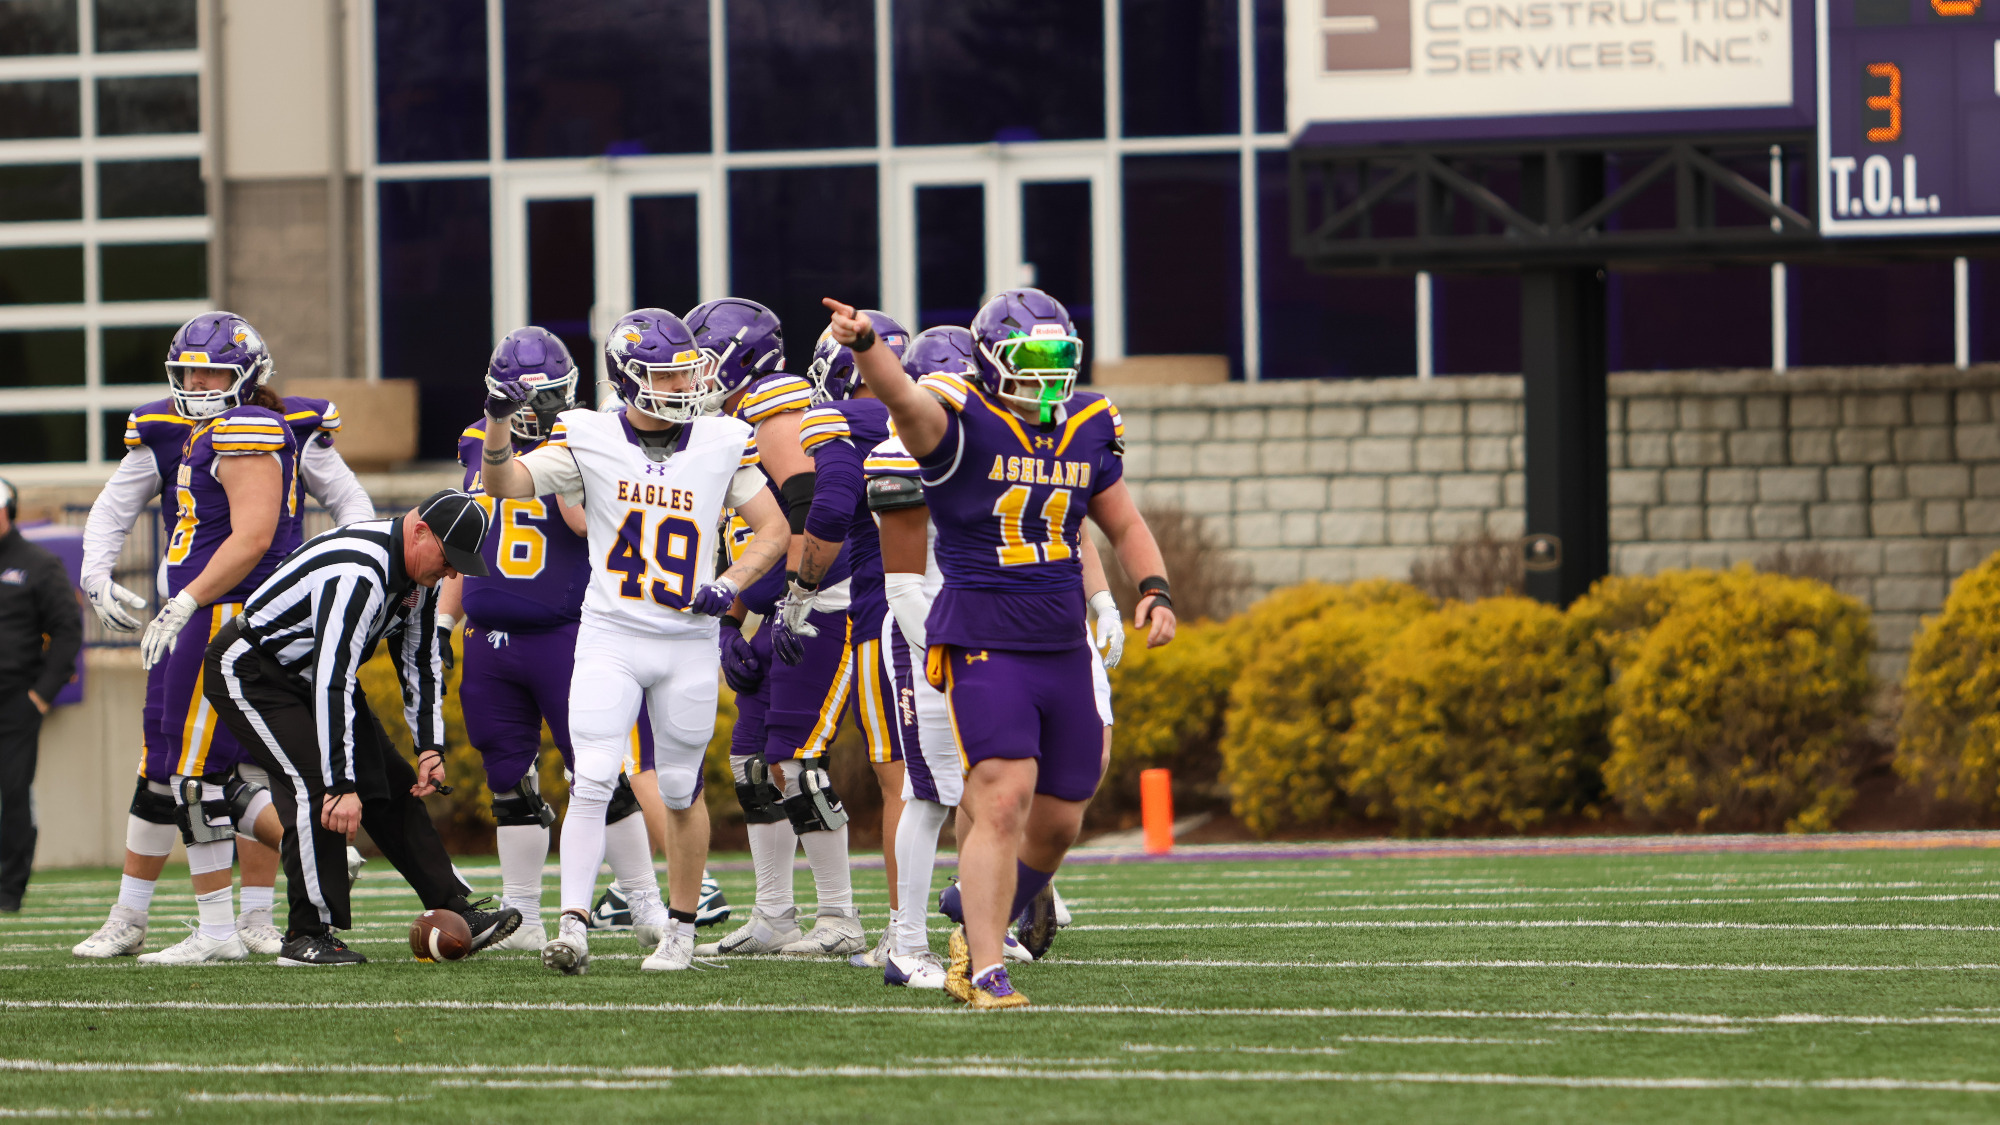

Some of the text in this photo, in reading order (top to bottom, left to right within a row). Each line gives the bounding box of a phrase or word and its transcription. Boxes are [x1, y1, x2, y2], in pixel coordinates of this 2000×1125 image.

[1426, 40, 1665, 74] SERVICES,
[1866, 62, 1901, 142] 3
[1830, 154, 1940, 216] T.O.L.
[618, 480, 693, 512] EAGLES
[988, 454, 1091, 488] ASHLAND
[992, 484, 1072, 567] 11
[606, 508, 701, 612] 49
[898, 687, 915, 726] Eagles
